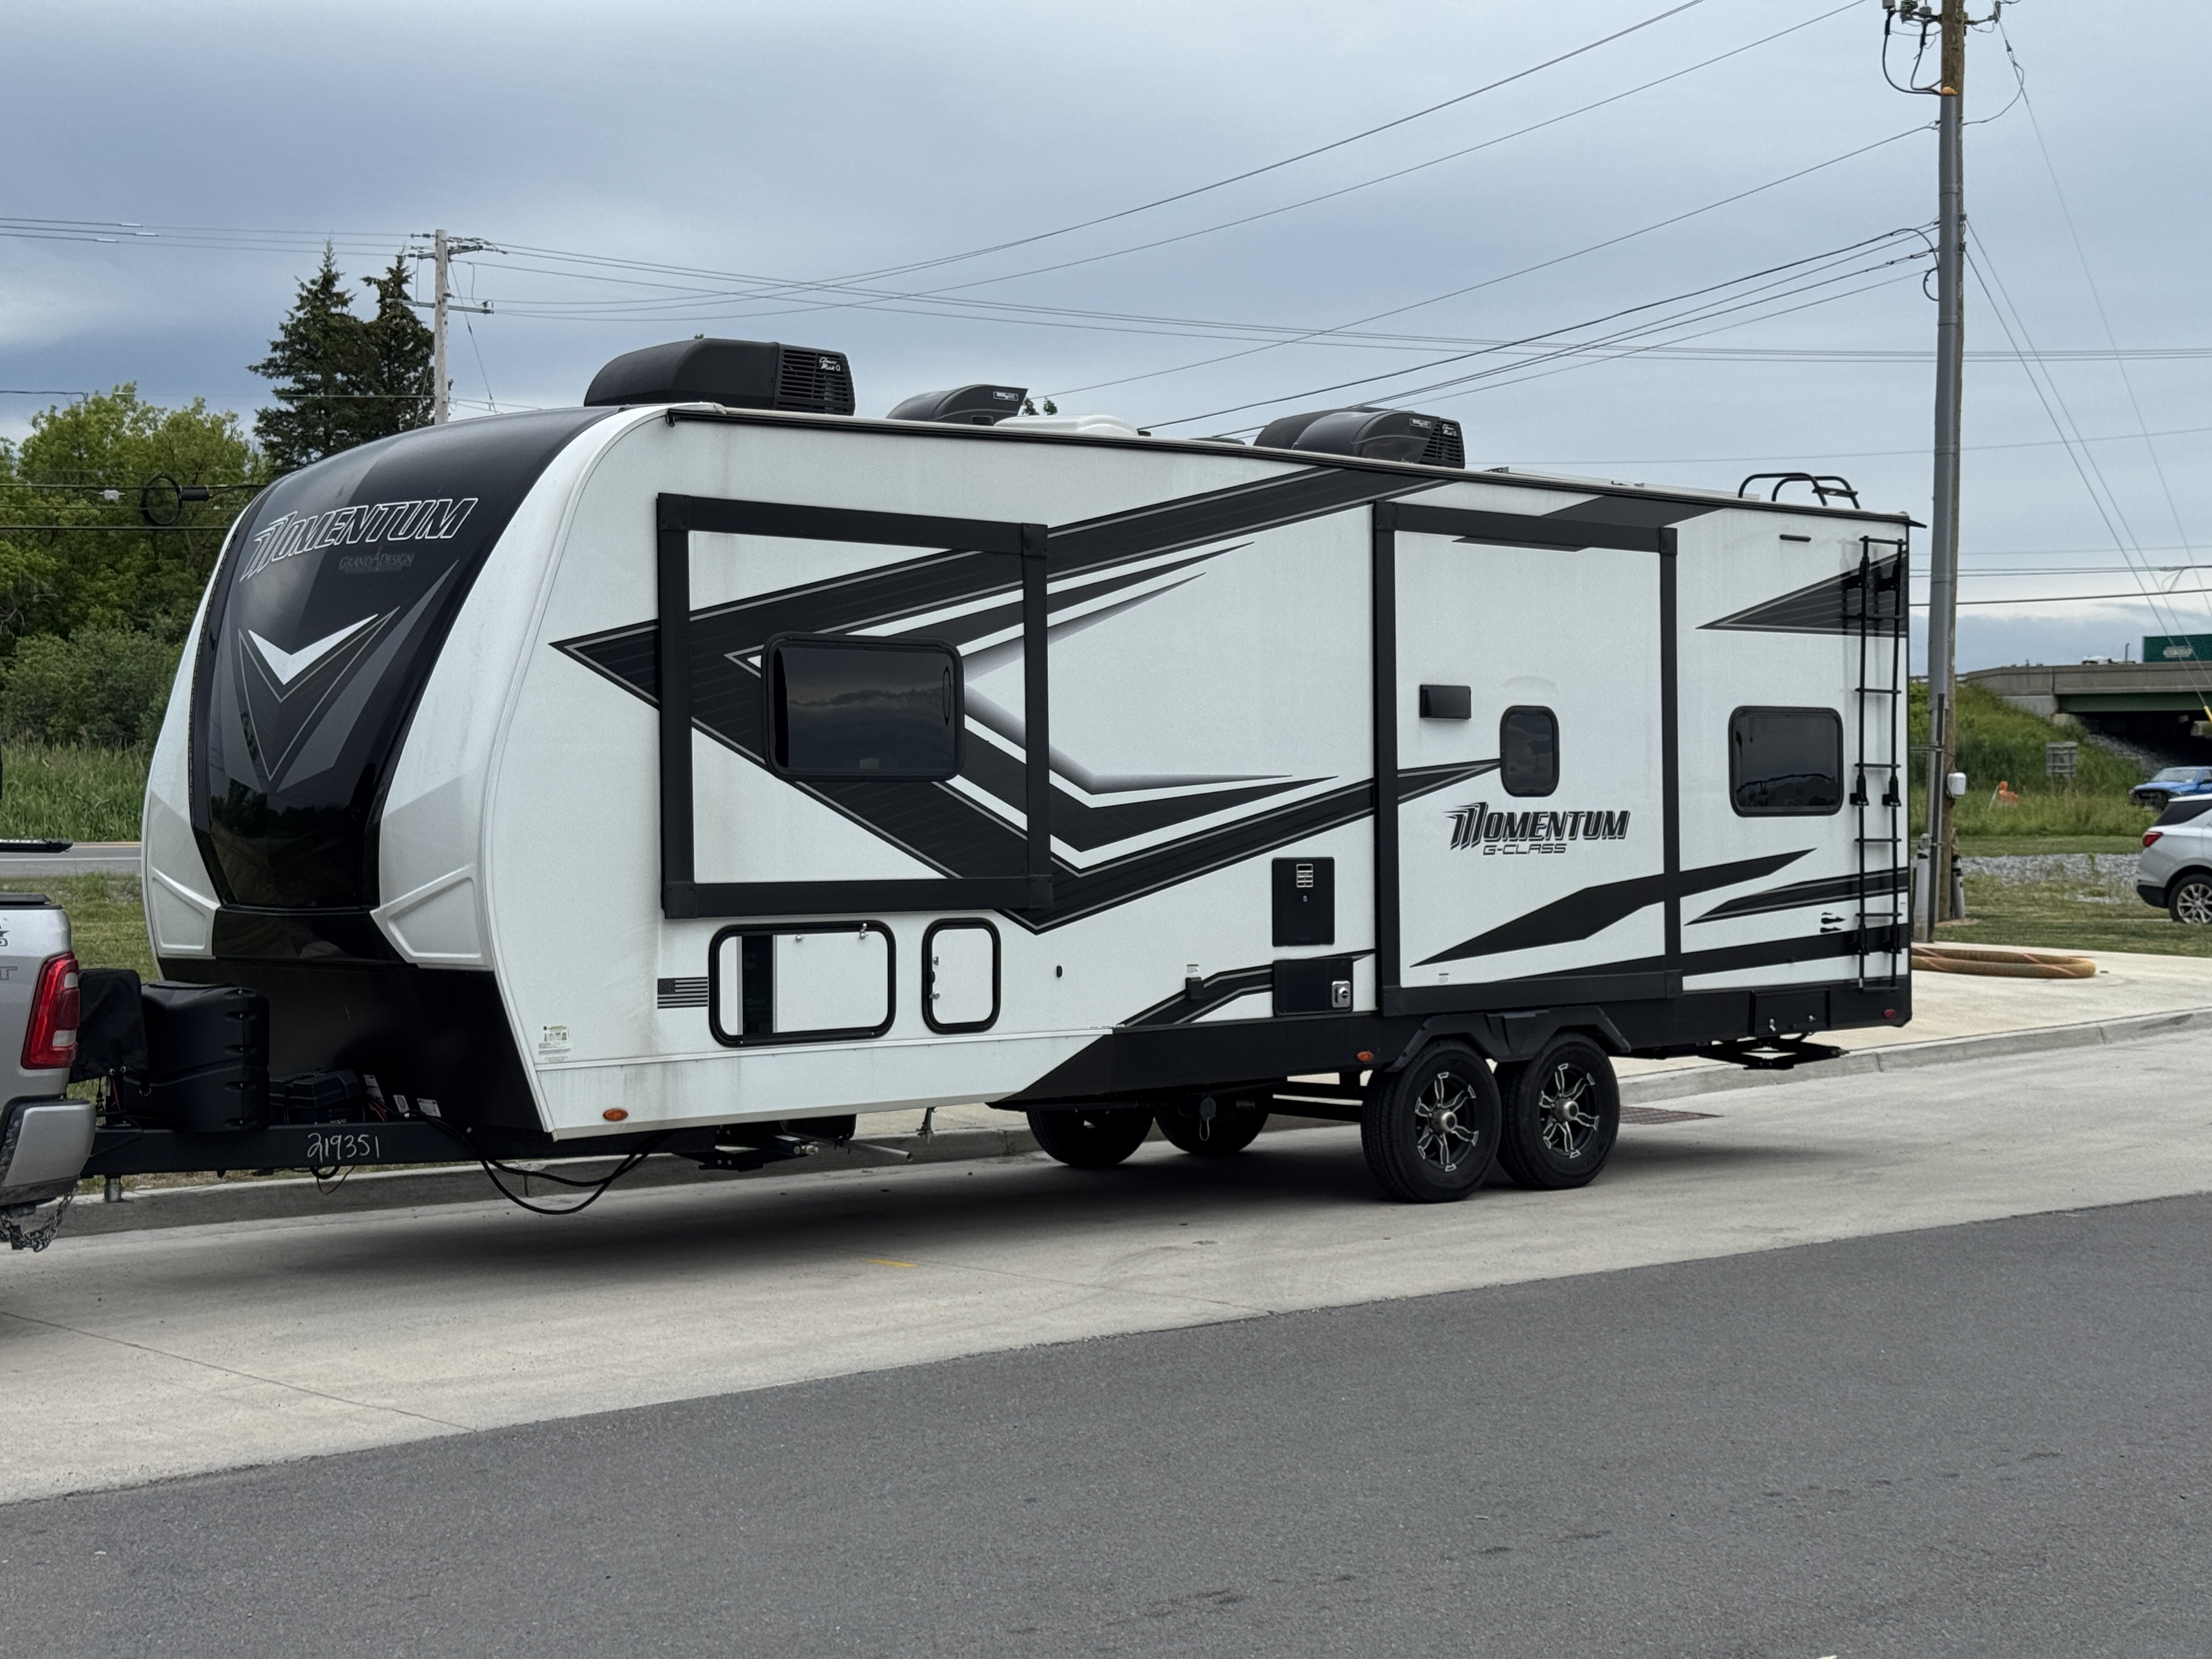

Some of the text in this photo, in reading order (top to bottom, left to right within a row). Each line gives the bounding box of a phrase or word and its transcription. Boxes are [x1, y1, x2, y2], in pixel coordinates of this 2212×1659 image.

[240, 498, 479, 583] MOMENTUM
[1444, 802, 1630, 850] MOMENTUM
[1483, 843, 1567, 856] G-CLASS
[307, 1132, 380, 1163] 219351
